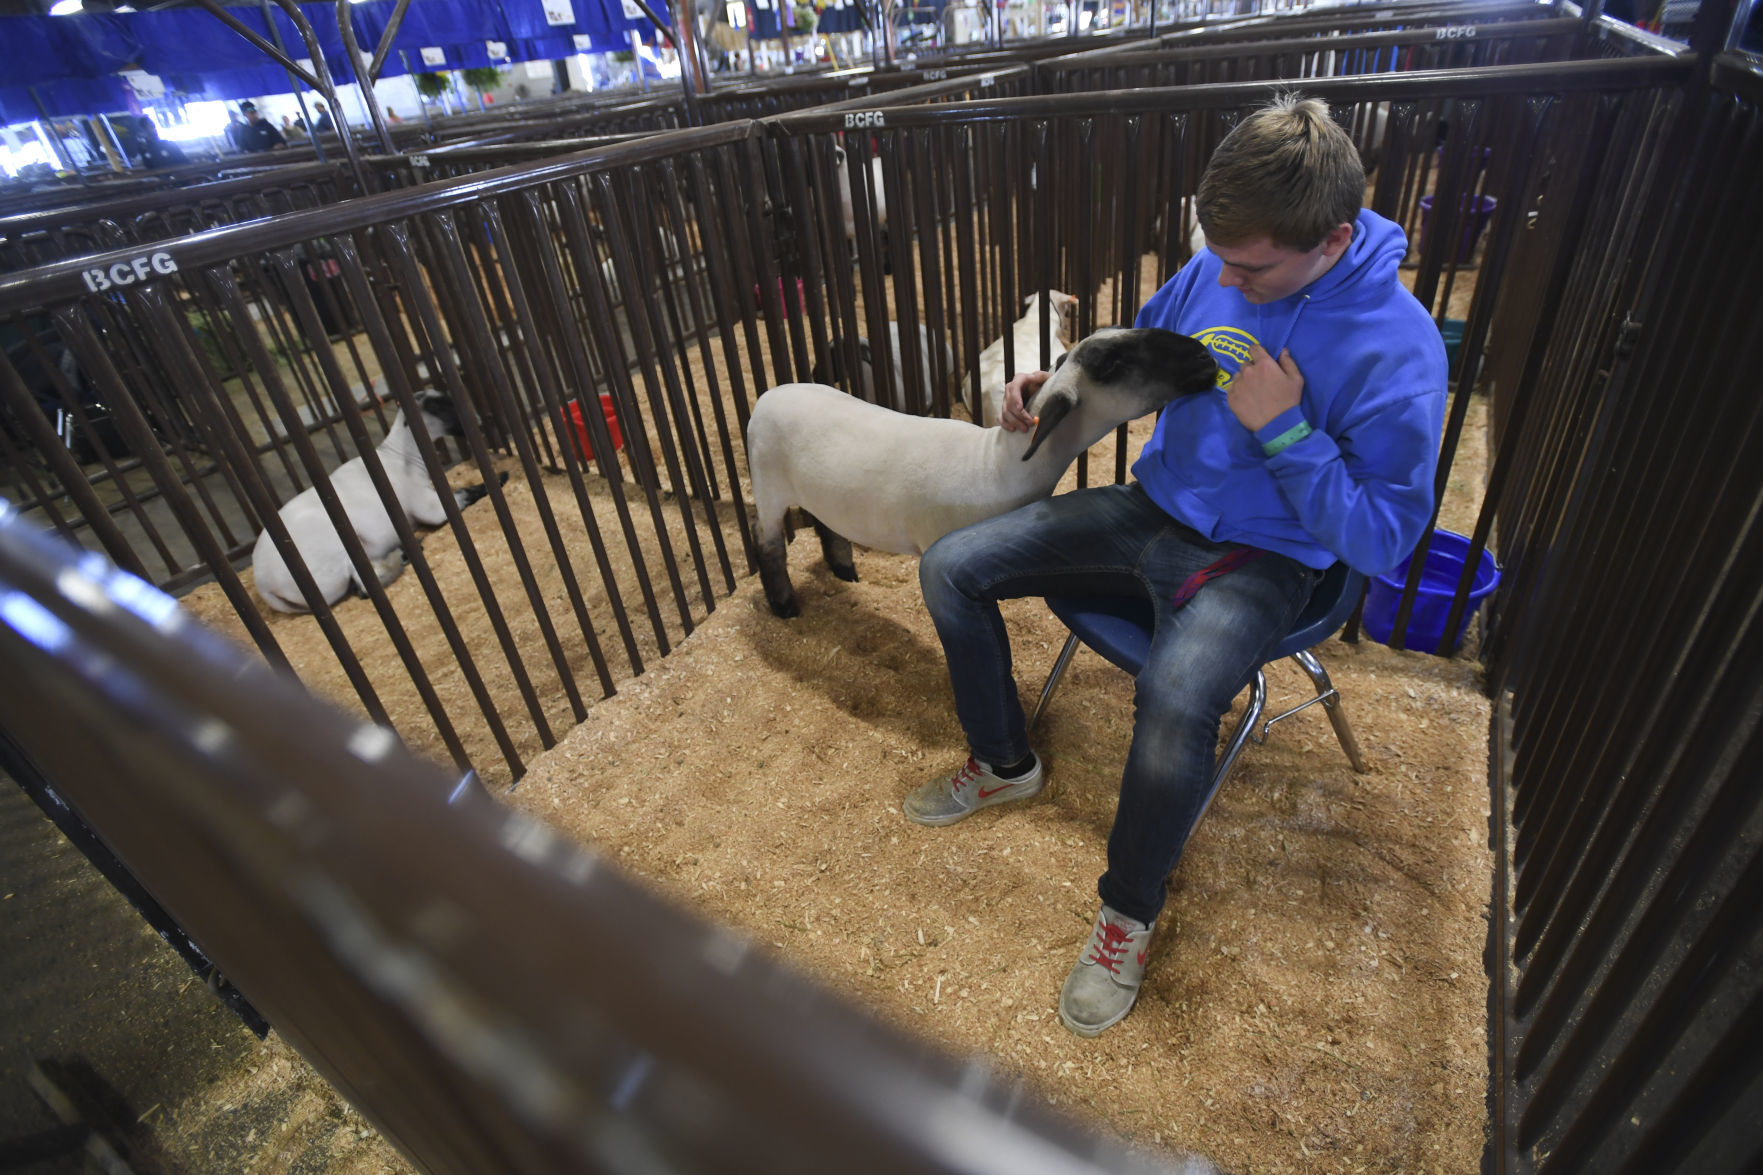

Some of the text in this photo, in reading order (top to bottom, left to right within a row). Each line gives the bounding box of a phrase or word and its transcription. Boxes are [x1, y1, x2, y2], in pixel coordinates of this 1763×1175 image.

[1436, 25, 1476, 40] BCFG
[845, 111, 885, 128] BCFG
[82, 252, 178, 293] BCFG
